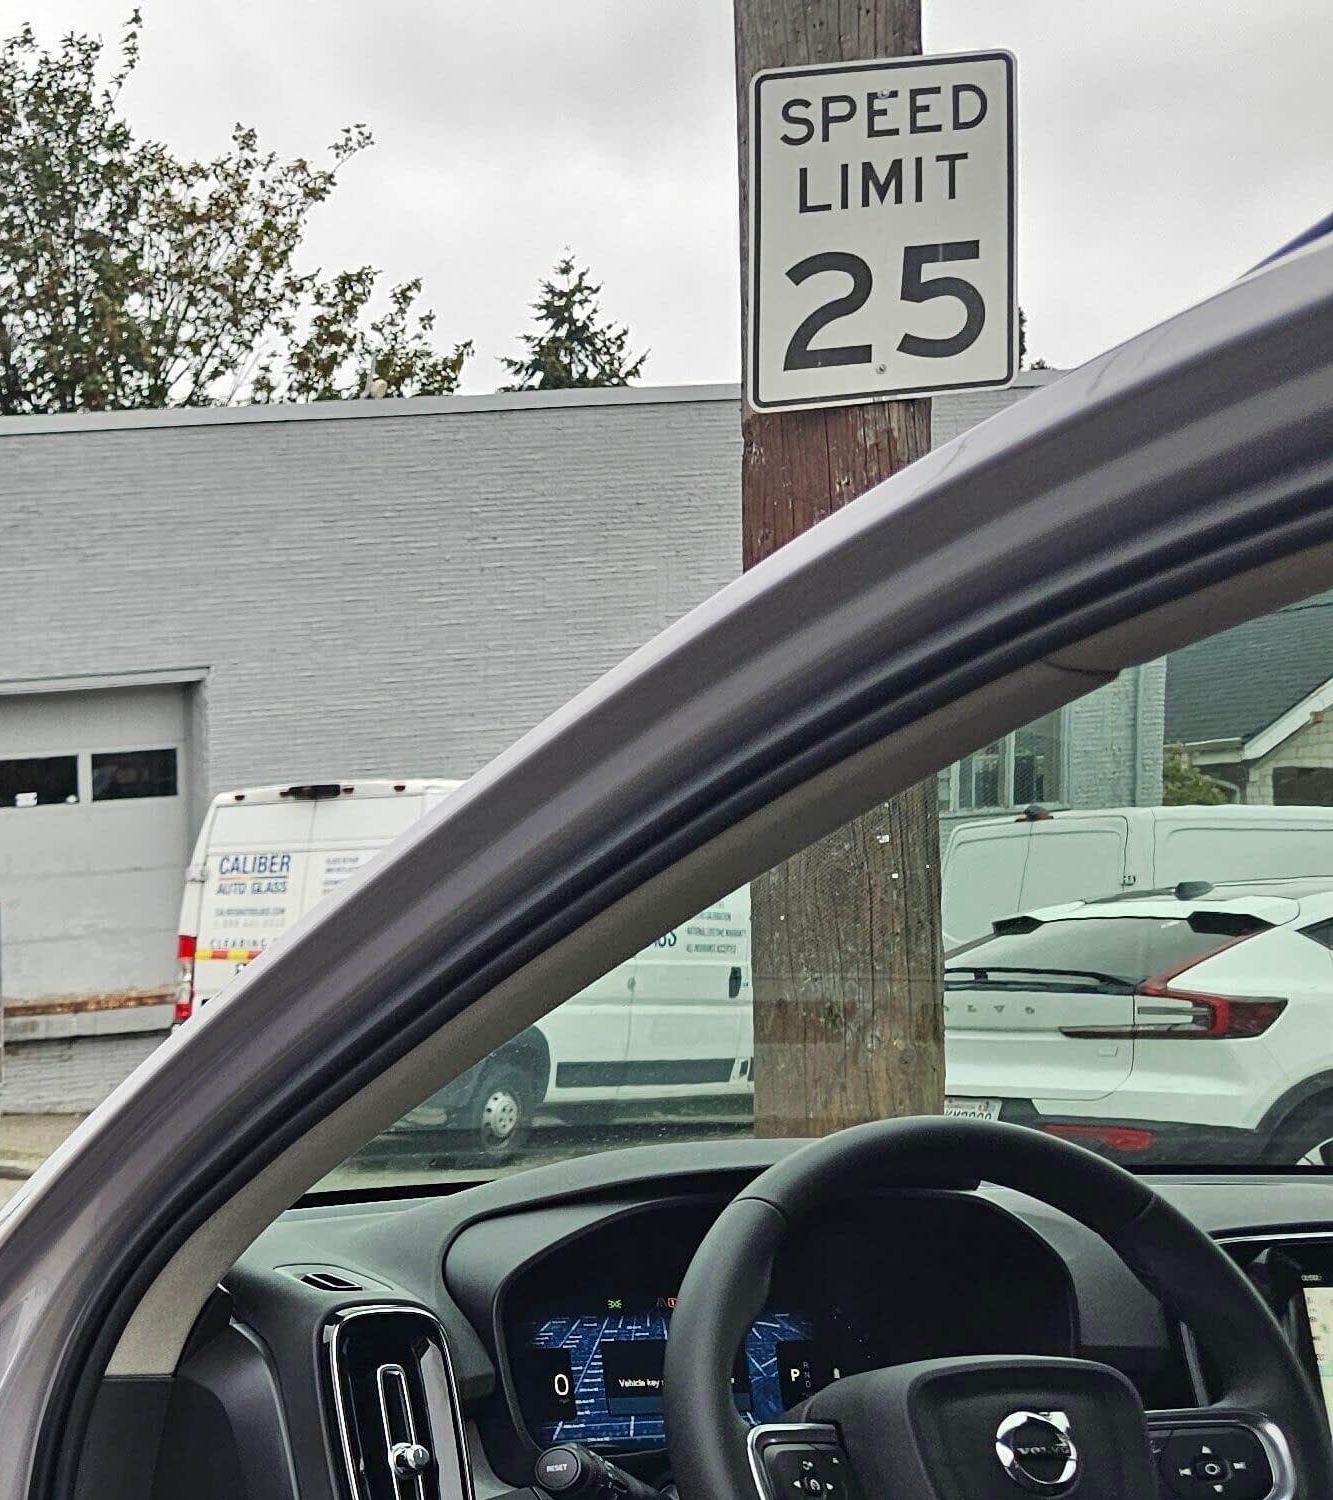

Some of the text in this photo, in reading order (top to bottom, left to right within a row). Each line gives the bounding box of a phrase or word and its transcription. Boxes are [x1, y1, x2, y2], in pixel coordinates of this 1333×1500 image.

[780, 84, 988, 146] SPEED
[799, 152, 969, 214] LIMIT
[783, 239, 986, 371] 25
[220, 855, 291, 875] CALIBER
[217, 881, 288, 895] AUTO GLASS
[944, 1004, 1035, 1015] LVO
[618, 1378, 660, 1389] Vehicle key
[790, 1368, 801, 1382] P
[554, 1373, 570, 1396] 0
[546, 1463, 568, 1473] RESET
